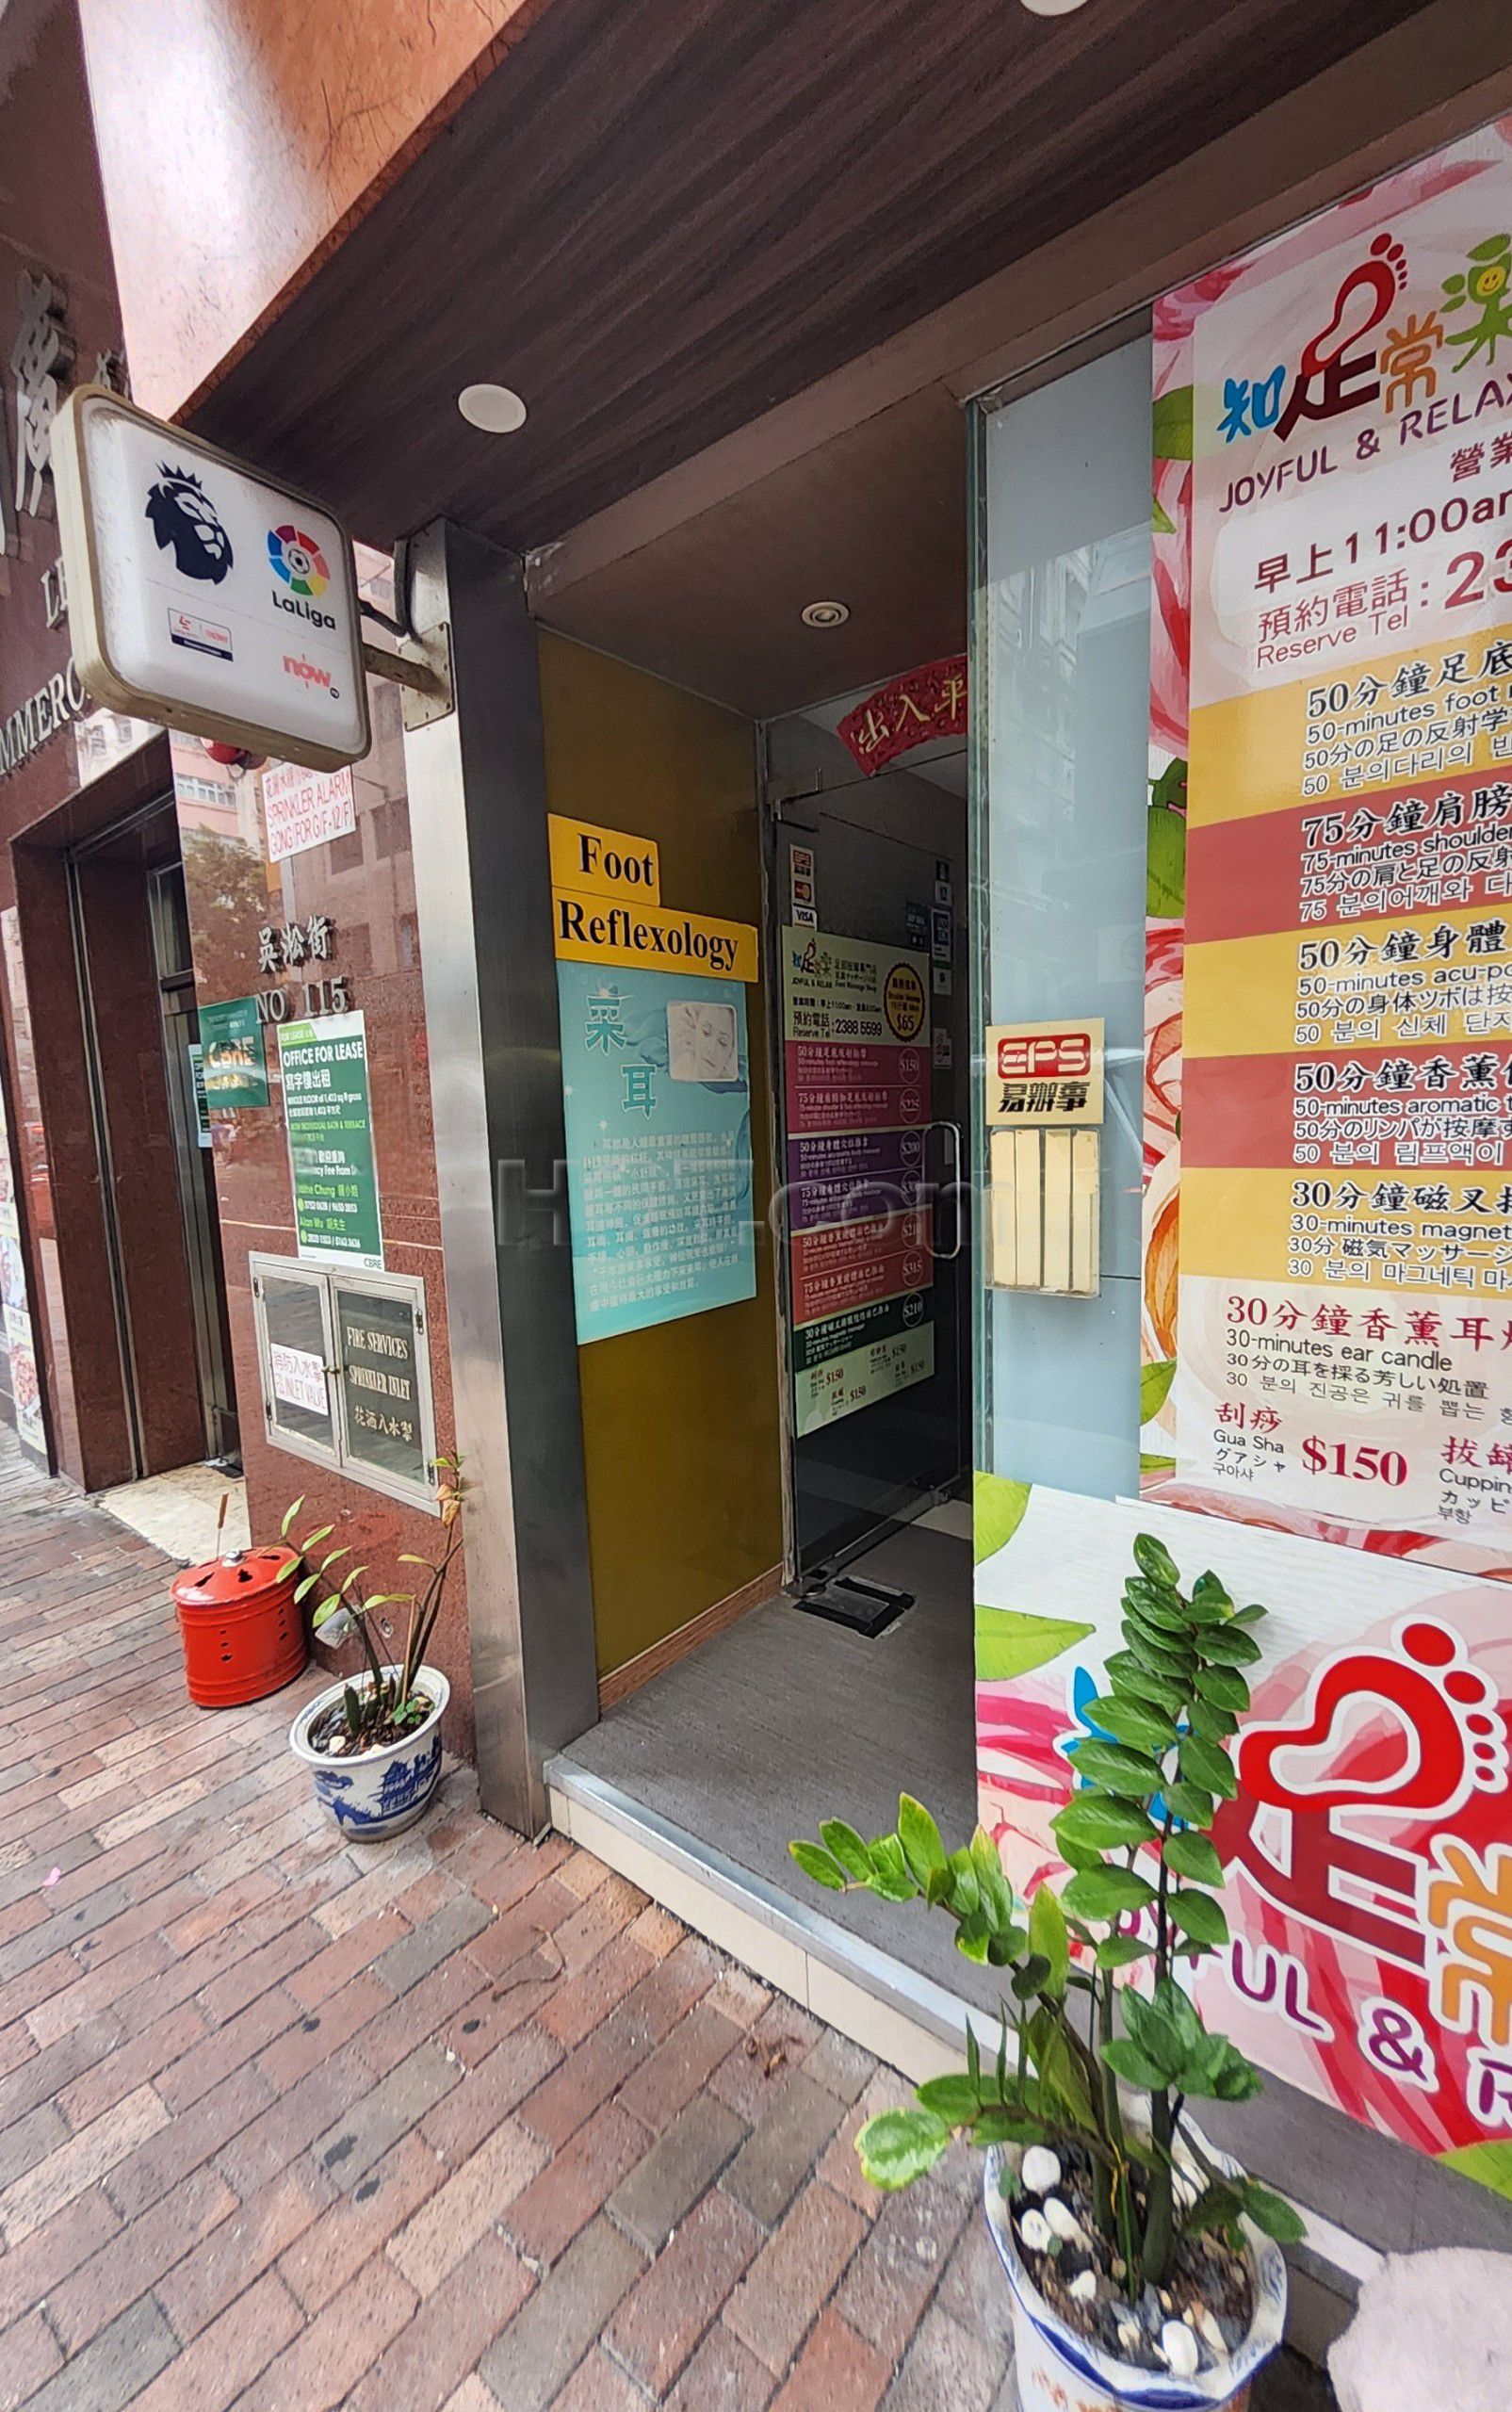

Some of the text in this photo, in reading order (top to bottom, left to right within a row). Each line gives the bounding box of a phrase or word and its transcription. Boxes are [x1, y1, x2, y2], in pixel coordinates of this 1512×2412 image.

[1219, 381, 1512, 513] JOYFUL & RELA
[271, 589, 336, 630] LaLiga
[1258, 606, 1409, 668] Reserve Tel
[283, 654, 332, 689] now
[1308, 685, 1499, 744] 50-minutes foot
[1304, 774, 1328, 795] 50
[577, 833, 655, 887] Foot
[1302, 844, 1416, 873] 75-minutes
[796, 909, 814, 923] VISA
[1301, 901, 1326, 921] 75
[557, 899, 739, 971] Reflexology
[1300, 971, 1424, 997] 50-minutes
[256, 989, 285, 1024] NO
[301, 975, 346, 1017] 115
[836, 1019, 883, 1036] 2388 5599
[896, 1013, 915, 1031] $65
[1296, 1025, 1320, 1043] 50
[1333, 1019, 1380, 1042] 분의
[1397, 1014, 1446, 1037] 신체
[283, 1041, 364, 1067] OFFICE FOR LEASE
[1001, 1038, 1087, 1074] EPS
[1296, 1053, 1512, 1091] 50分鐘香薰
[998, 1082, 1090, 1113] 易辦事
[1295, 1093, 1498, 1116] 50-minutes aromatic
[1294, 1142, 1503, 1165] 50 분의 림프액이
[903, 1223, 920, 1237] $21
[1292, 1214, 1512, 1242] 30-minutes magnet
[364, 1258, 382, 1269] CBRE
[904, 1263, 921, 1276] $315
[1290, 1260, 1512, 1290] 30 분의 마그네틱 마
[904, 1302, 922, 1318] $210
[1227, 1296, 1512, 1351] 30分鐘香薰耳
[347, 1327, 409, 1360] FIRE SERVICES
[1227, 1328, 1453, 1373] 30-minutes ear candle
[388, 1375, 411, 1401] INLET
[826, 1368, 844, 1386] $150
[1226, 1372, 1248, 1386] 30
[1260, 1375, 1296, 1394] 분의
[850, 1385, 867, 1402] $150
[1213, 1429, 1285, 1454] Gua Sha
[1302, 1435, 1407, 1487] $150
[1439, 1468, 1512, 1494] Cuppin
[1369, 2006, 1428, 2083] &
